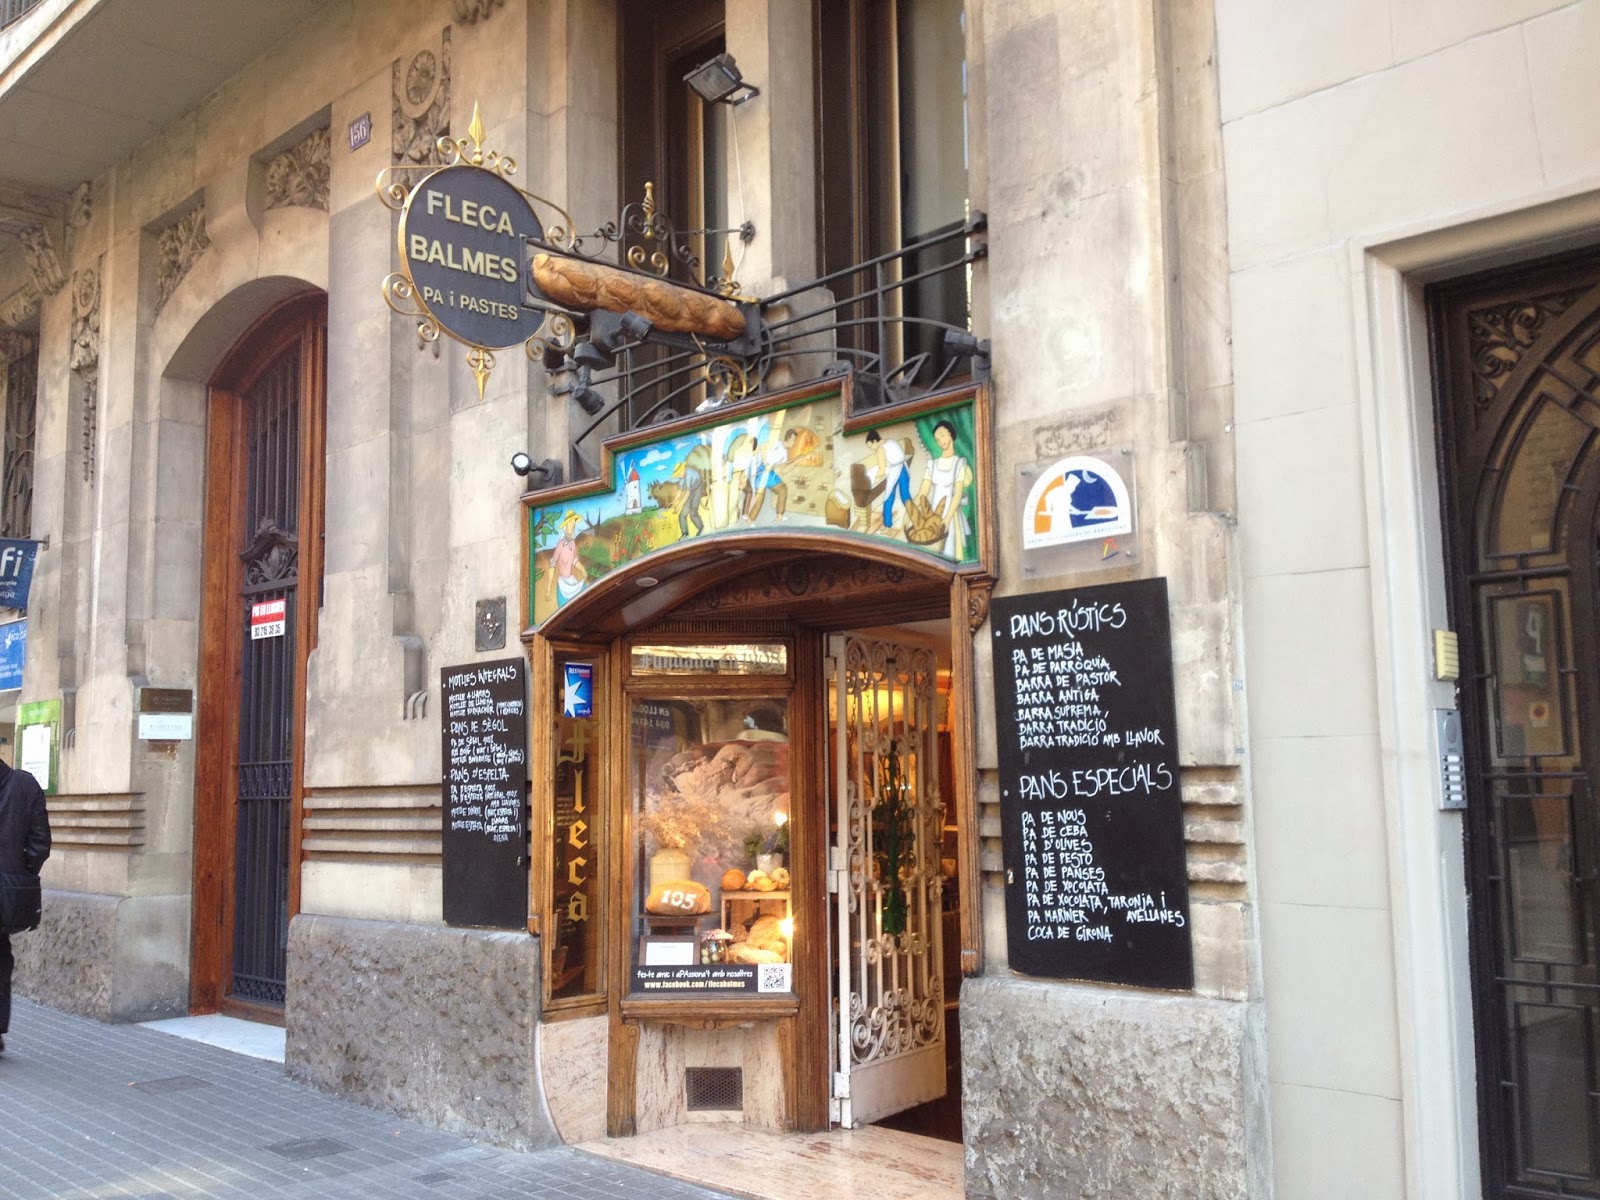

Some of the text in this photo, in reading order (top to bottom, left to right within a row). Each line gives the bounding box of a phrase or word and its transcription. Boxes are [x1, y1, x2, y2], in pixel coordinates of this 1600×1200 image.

[427, 189, 515, 238] FLECA
[410, 234, 518, 283] BALMES
[423, 286, 519, 321] PA i PASTES
[1010, 611, 1055, 639] PANS
[1012, 649, 1028, 665] PA
[1032, 648, 1045, 661] DE
[1015, 663, 1030, 678] PA
[1032, 662, 1047, 674] DE
[1015, 670, 1122, 693] BARRA DE PASTOR
[1016, 690, 1054, 705] BARRA
[1016, 704, 1102, 721] BARRA SUPREMA
[1019, 721, 1054, 735] BARRA
[1020, 733, 1055, 751] BARRA
[1102, 734, 1120, 747] AMB
[1126, 727, 1165, 748] LLAVOR
[1020, 770, 1068, 800] PANS
[1022, 809, 1087, 828] PA DE NOUS
[1023, 825, 1088, 841] PA DE CEBA
[1023, 840, 1037, 852] PA
[1025, 853, 1093, 868] PA DE PESTO
[1025, 866, 1105, 881] PA DE PANSES
[1026, 879, 1108, 895] PA DE XOCOLATA
[661, 890, 697, 910] 105
[1027, 895, 1040, 907] PA
[1042, 894, 1055, 906] DE
[1028, 910, 1040, 924] PA
[1126, 909, 1185, 927] AVELLANES
[1028, 926, 1054, 940] COCA
[1057, 927, 1070, 939] DE
